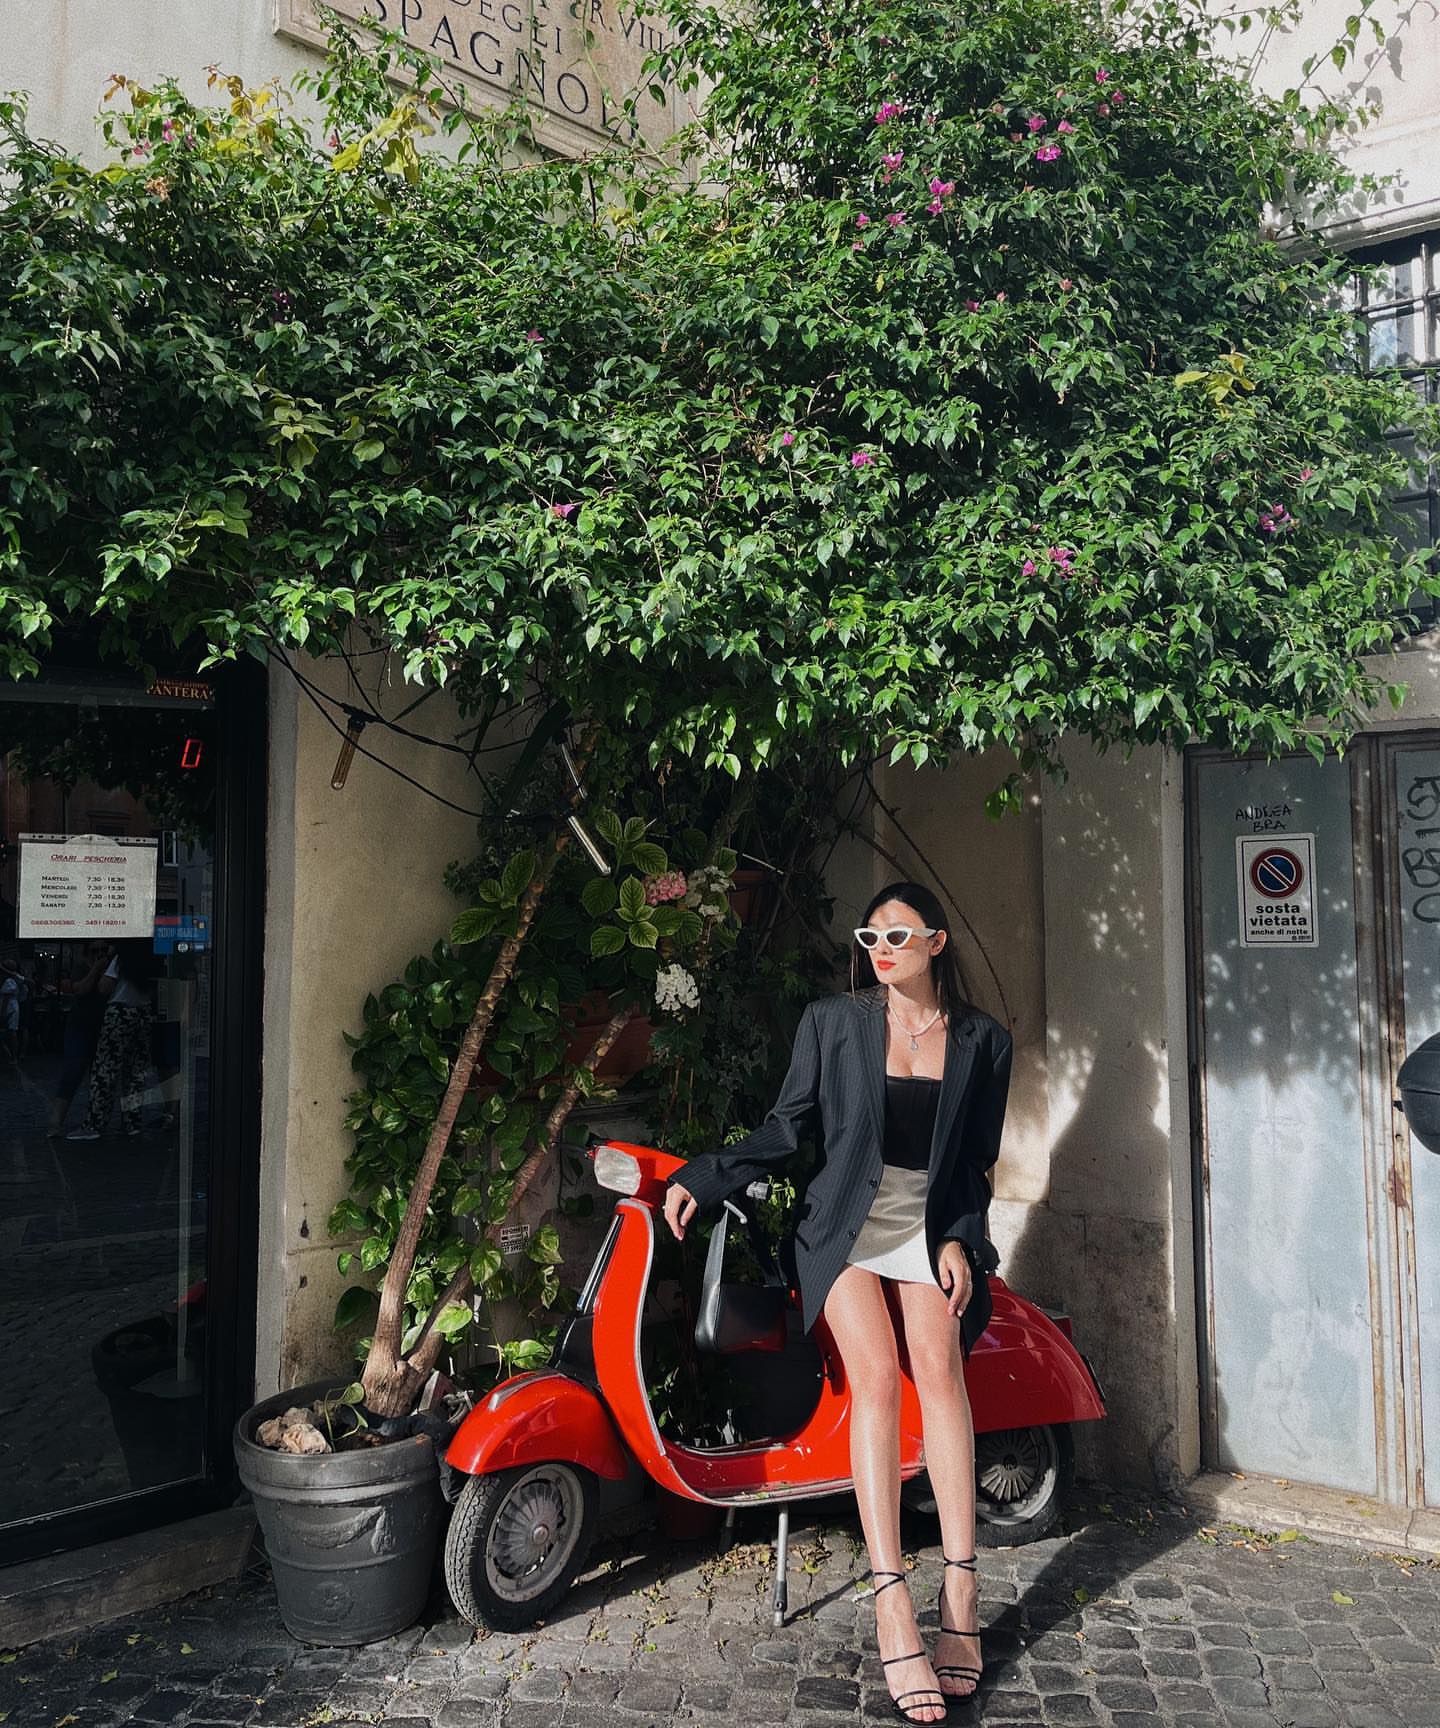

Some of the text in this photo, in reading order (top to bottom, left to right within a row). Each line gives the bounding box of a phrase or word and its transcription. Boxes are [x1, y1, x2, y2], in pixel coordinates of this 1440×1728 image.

[448, 0, 561, 54] EGLI
[84, 856, 127, 864] PESCHERIA
[1256, 903, 1300, 914] sosta
[1249, 915, 1307, 926] vietata
